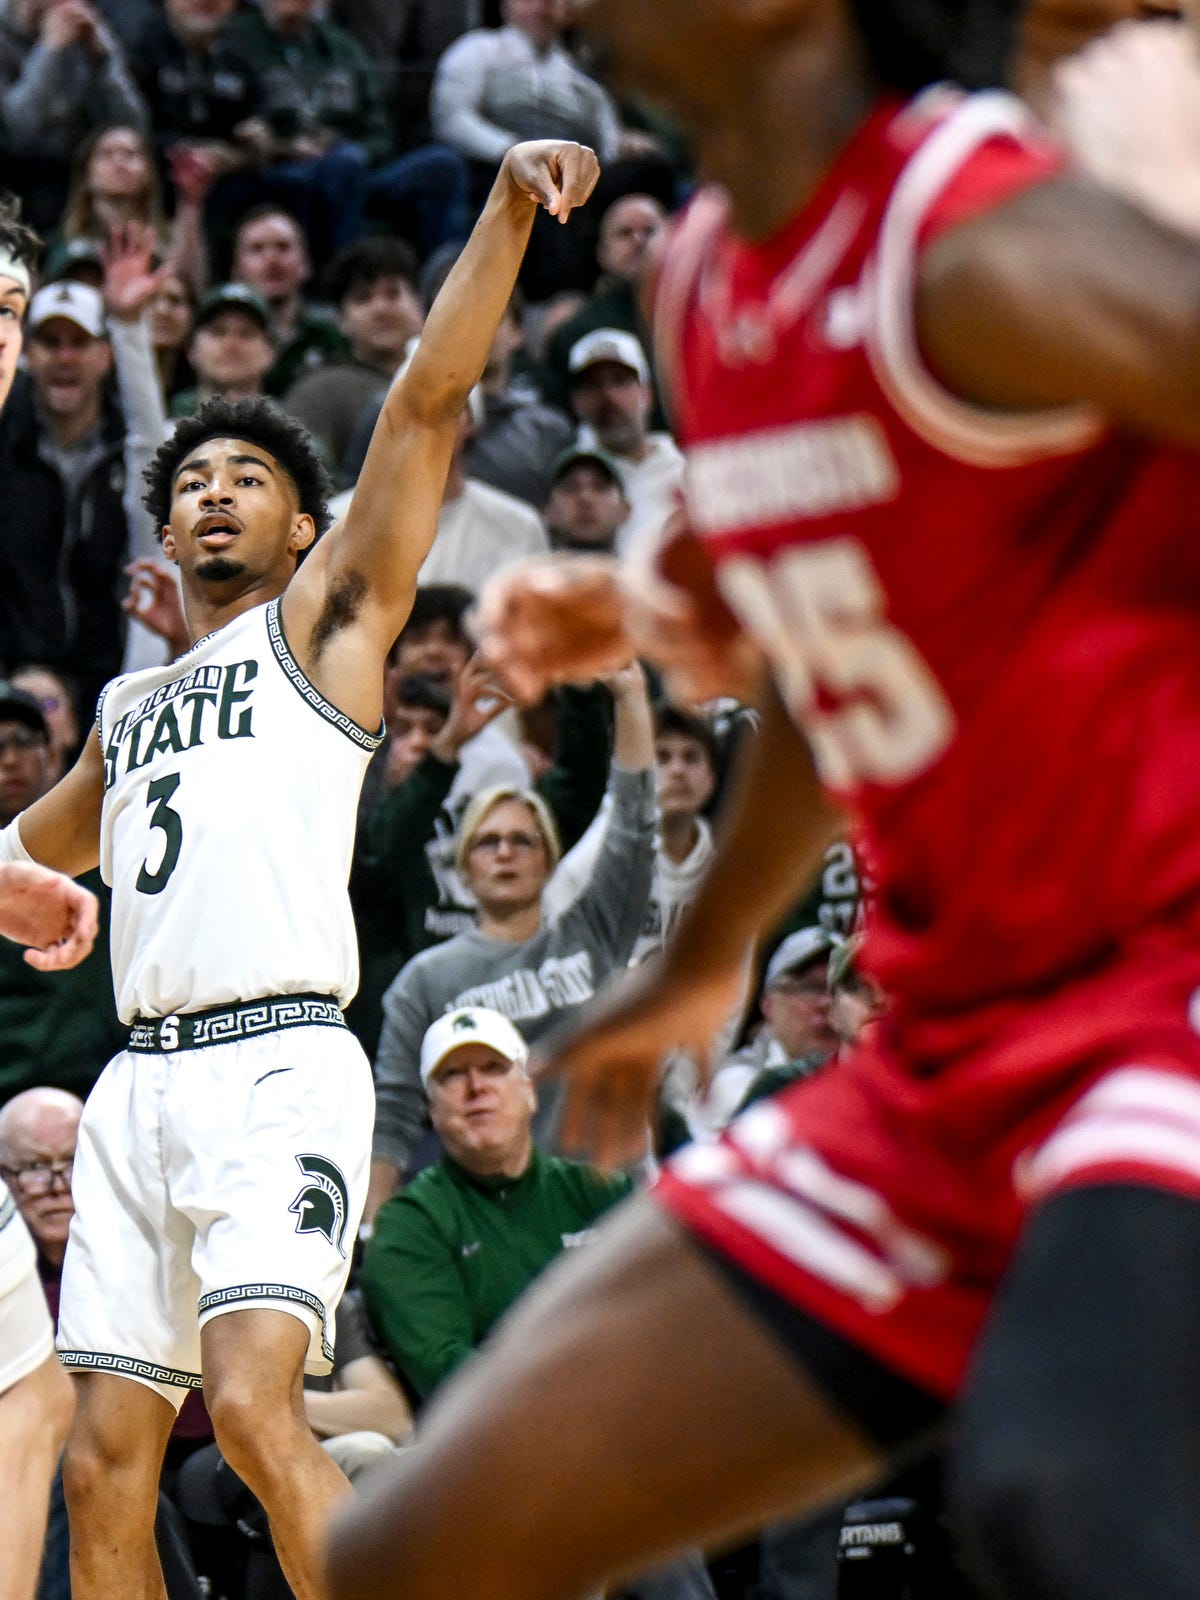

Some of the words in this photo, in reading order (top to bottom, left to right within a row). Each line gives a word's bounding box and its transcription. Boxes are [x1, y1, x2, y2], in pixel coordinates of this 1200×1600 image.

[126, 665, 222, 729] MICHIGAN
[713, 536, 957, 788] 15
[104, 659, 260, 791] STATE
[135, 771, 183, 896] 3
[159, 1015, 180, 1050] S
